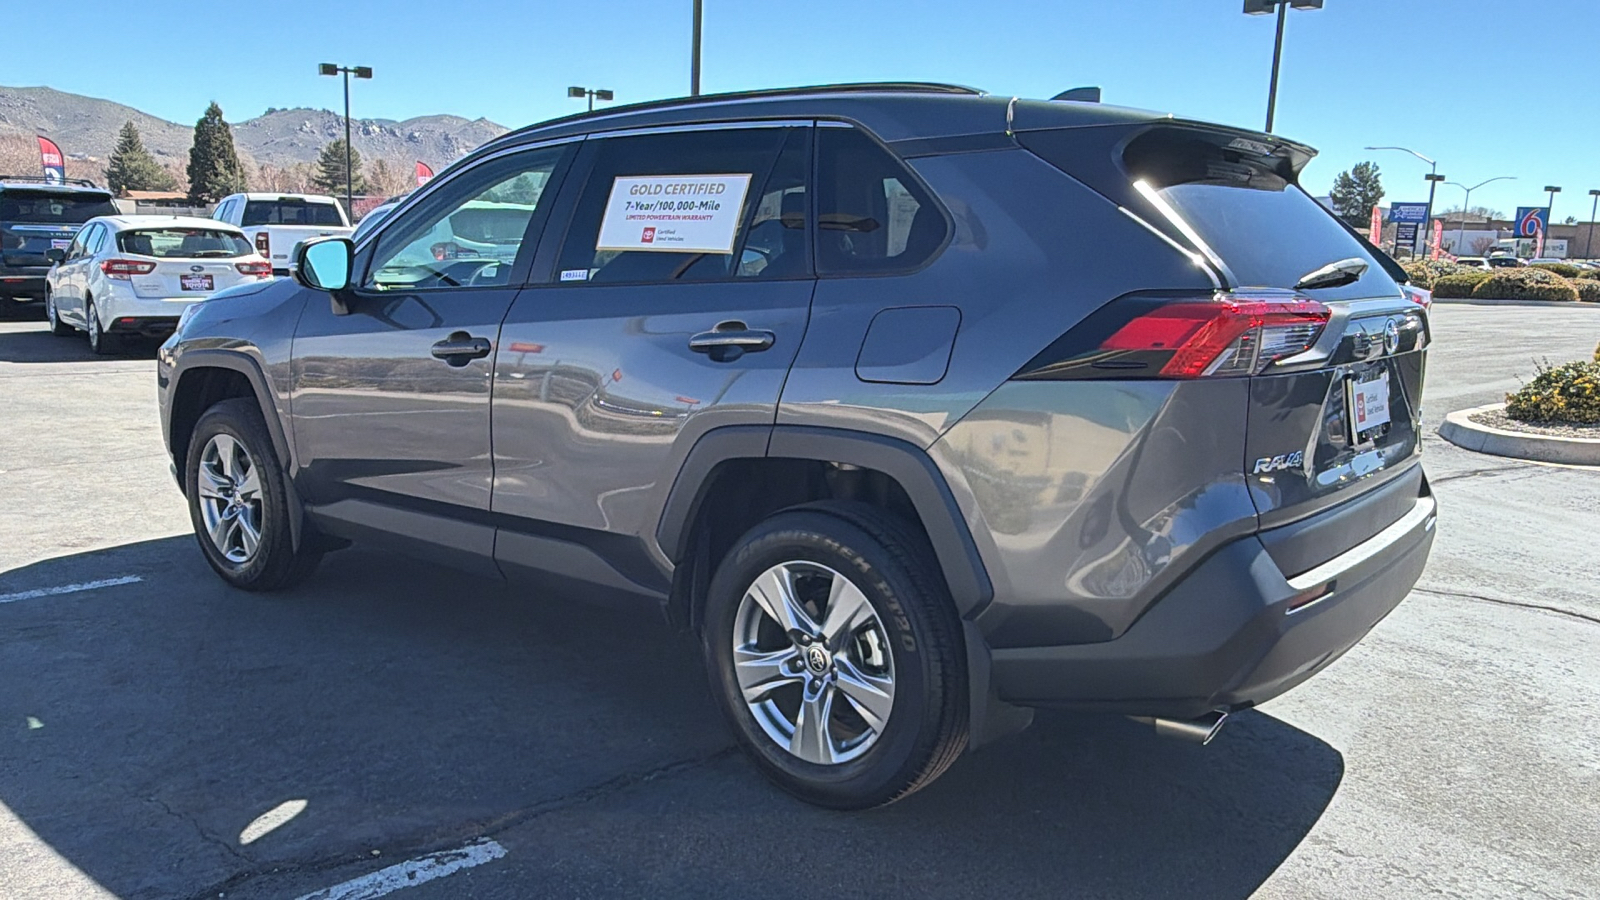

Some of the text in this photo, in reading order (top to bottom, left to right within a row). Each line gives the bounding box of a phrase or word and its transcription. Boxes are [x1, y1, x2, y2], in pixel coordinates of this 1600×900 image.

[630, 183, 726, 196] GOLD CERTIFIED
[625, 200, 720, 212] 7-Year/100,000-Mile
[1520, 208, 1543, 237] 6
[1253, 450, 1303, 474] RAV4
